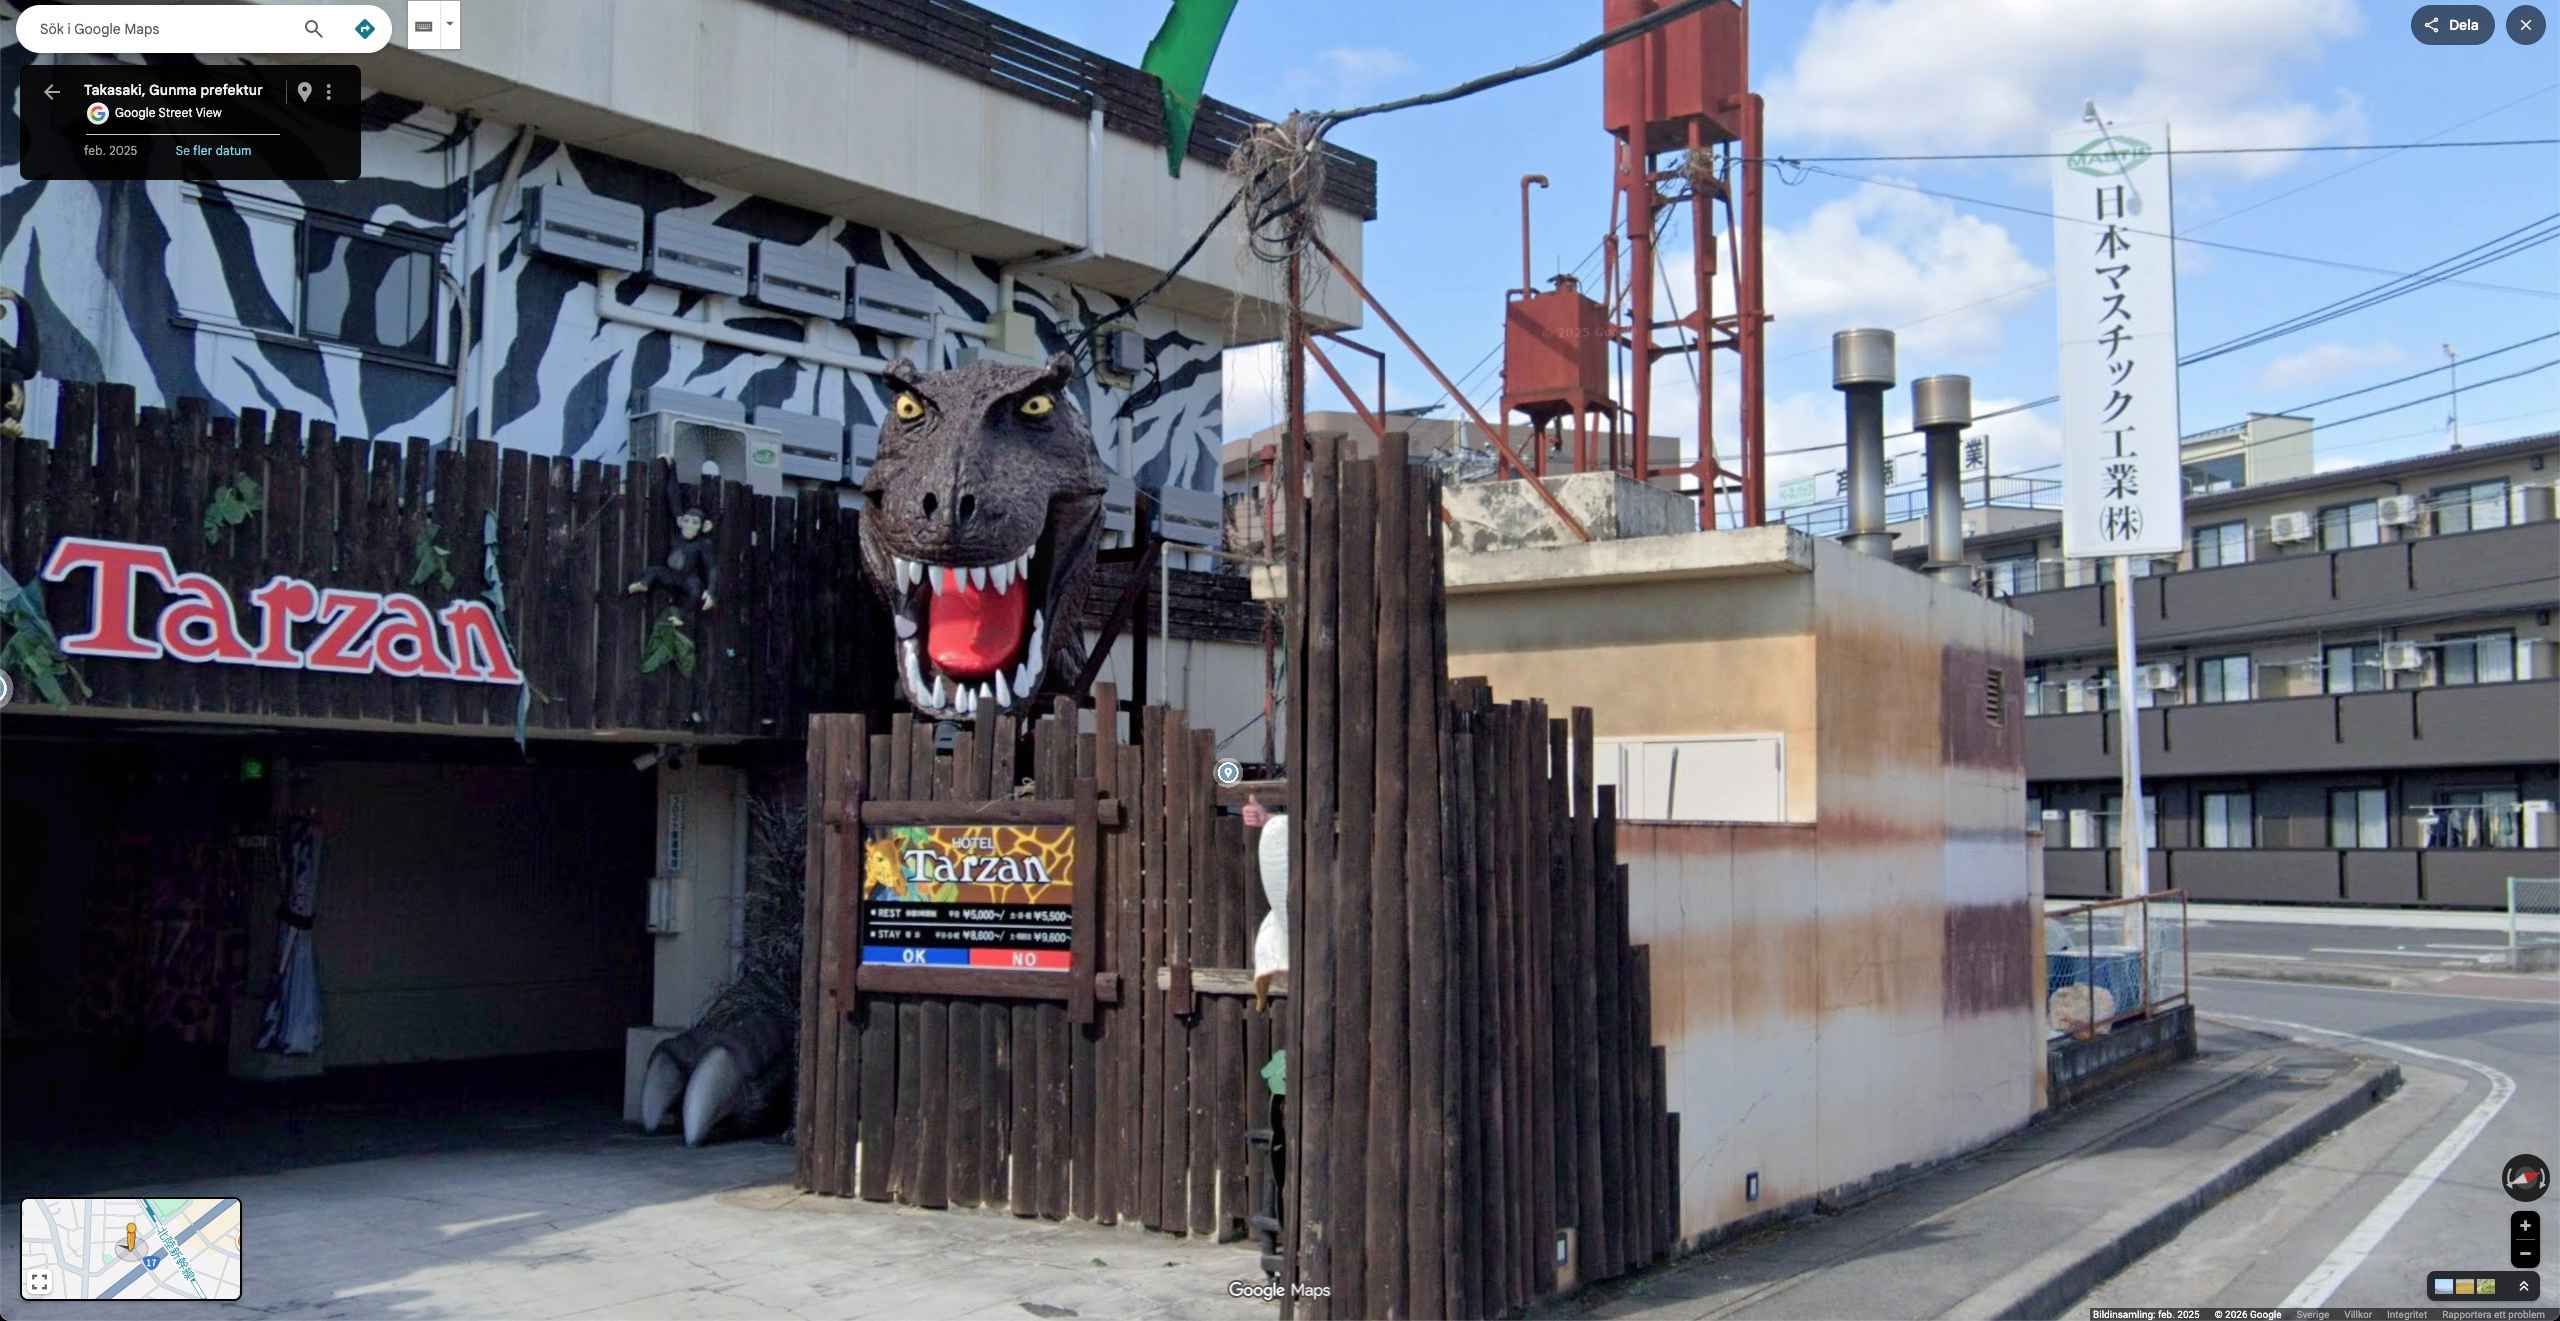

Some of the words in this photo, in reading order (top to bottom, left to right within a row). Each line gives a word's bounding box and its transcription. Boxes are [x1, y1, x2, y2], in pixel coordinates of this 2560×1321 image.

[41, 536, 524, 685] Tarzan
[952, 837, 994, 849] HOTEL
[904, 850, 1051, 883] Tarzan
[878, 909, 902, 918] REST
[878, 930, 902, 939] STAY
[902, 949, 927, 964] OK
[1012, 952, 1037, 966] NO
